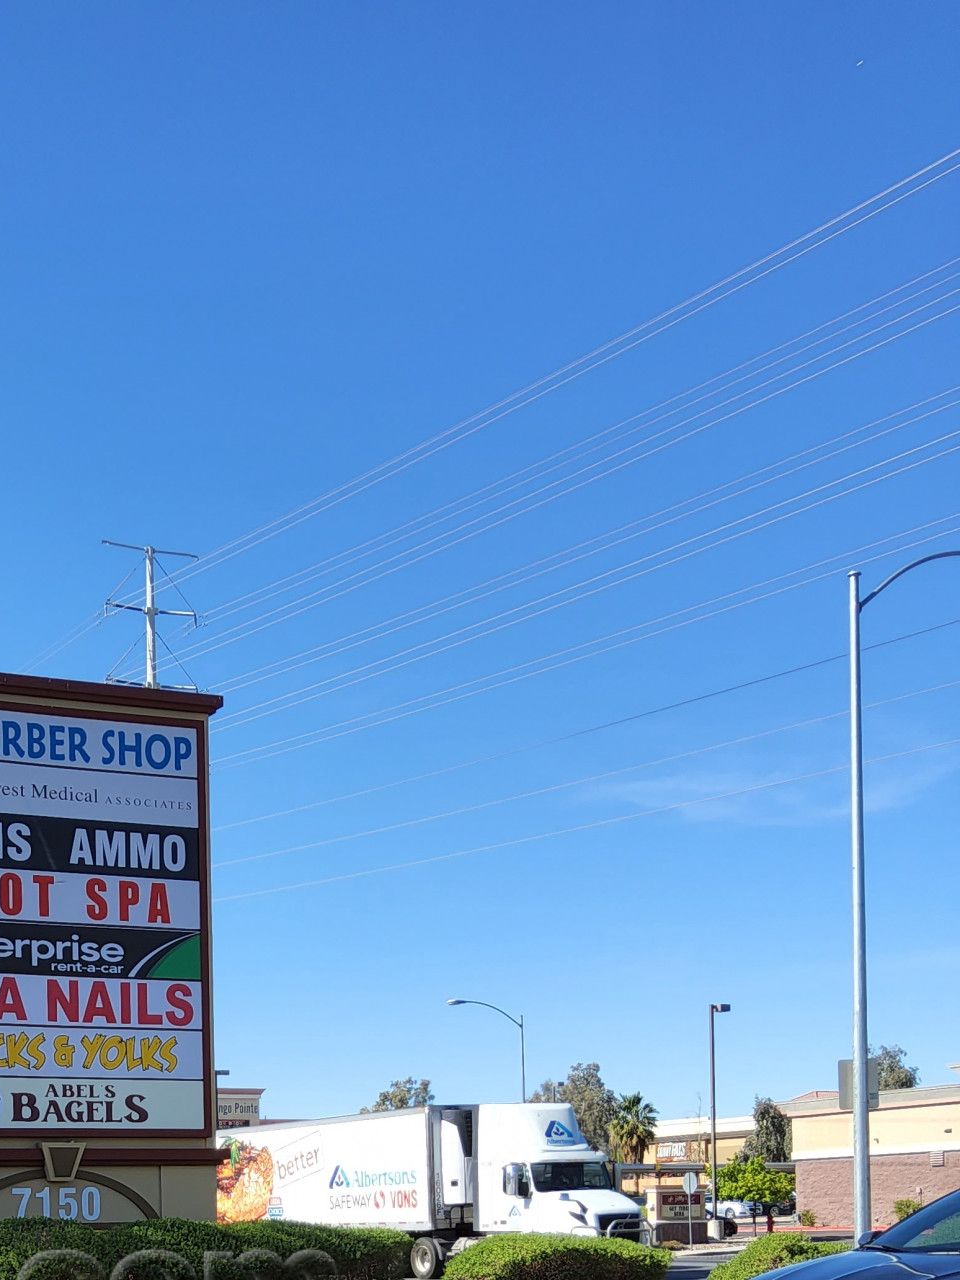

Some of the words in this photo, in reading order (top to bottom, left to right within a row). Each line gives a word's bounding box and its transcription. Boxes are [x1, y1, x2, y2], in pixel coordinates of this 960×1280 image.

[101, 729, 192, 771] SHOP
[31, 784, 99, 804] Medical
[105, 795, 193, 811] ASSOCIATES
[69, 828, 187, 872] AMMO
[85, 878, 171, 923] SPA
[51, 962, 124, 975] rent-a-car
[47, 979, 194, 1027] NAILS
[53, 1033, 76, 1068] &
[81, 1032, 179, 1073] YOLKS
[45, 1084, 116, 1099] ABEL'S
[11, 1093, 149, 1123] BAGELS
[218, 1104, 232, 1115] ngo
[234, 1102, 259, 1114] Pointe
[277, 1147, 320, 1180] better
[353, 1170, 417, 1188] Albertsons
[11, 1186, 101, 1221] 7150
[329, 1193, 372, 1210] SAFEWAY
[390, 1190, 418, 1209] VONS
